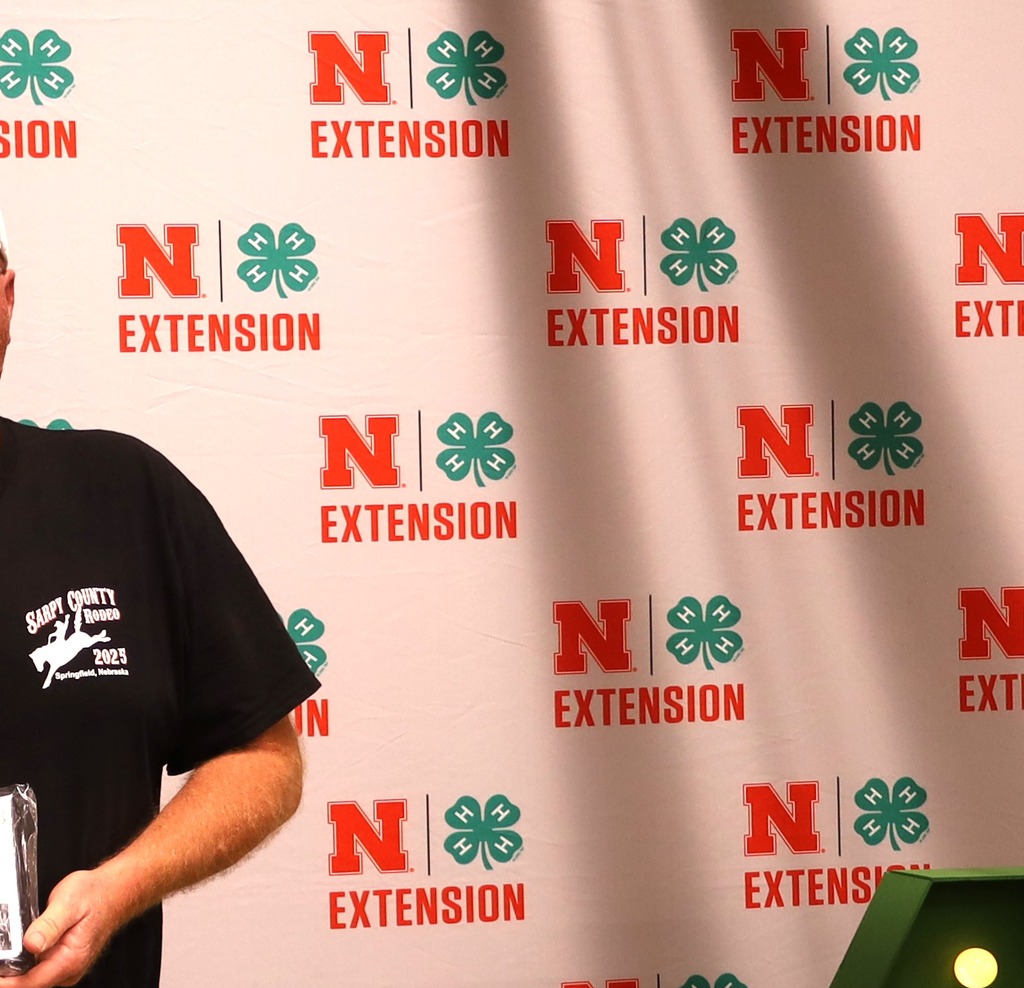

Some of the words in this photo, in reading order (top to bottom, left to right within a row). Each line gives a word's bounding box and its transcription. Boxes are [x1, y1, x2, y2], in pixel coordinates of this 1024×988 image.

[308, 31, 391, 105] N
[730, 29, 811, 102] N
[311, 119, 510, 158] EXTENSION
[732, 114, 921, 154] EXTENSION
[116, 224, 201, 299] N
[545, 220, 623, 294] N
[955, 212, 1024, 285] N
[119, 313, 321, 353] EXTENSION
[546, 305, 739, 347] EXTENSION
[319, 414, 401, 490] N
[737, 404, 815, 479] N
[321, 501, 517, 543] EXTENSION
[737, 488, 925, 532] EXTENSION
[25, 596, 64, 634] SARPY
[67, 587, 116, 612] COUNTY
[83, 608, 121, 624] RODEO
[958, 587, 1024, 660] N
[93, 647, 128, 665] 2025
[553, 599, 633, 675] N
[55, 668, 97, 680] Springfield,
[98, 668, 129, 677] Nebraska
[554, 683, 745, 728] EXTENSION
[327, 798, 411, 876] N
[743, 781, 821, 857] N
[329, 883, 525, 930] EXTENSION
[744, 864, 930, 909] EXTENS
